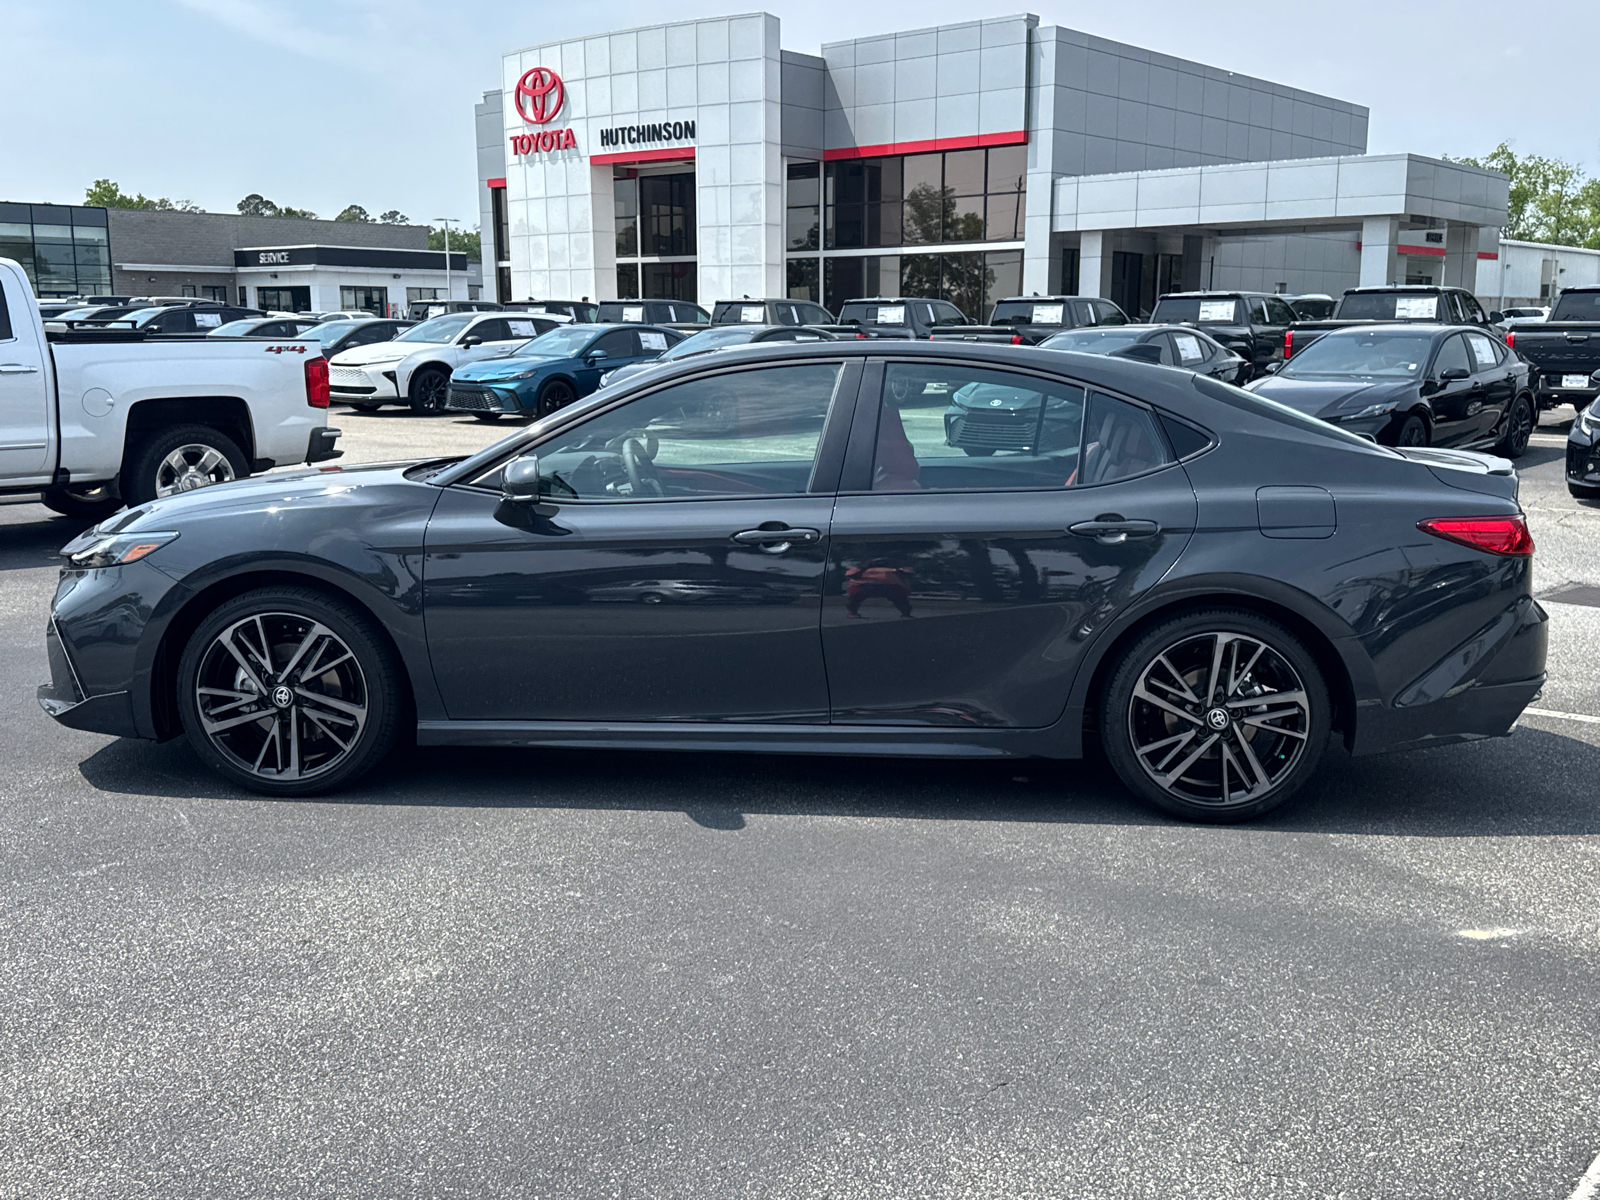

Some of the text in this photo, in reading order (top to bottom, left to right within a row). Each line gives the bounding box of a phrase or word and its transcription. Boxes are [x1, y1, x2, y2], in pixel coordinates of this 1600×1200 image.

[509, 128, 576, 156] TOYOTA
[600, 120, 696, 147] HUTCHINSON
[259, 252, 290, 263] SERVICE
